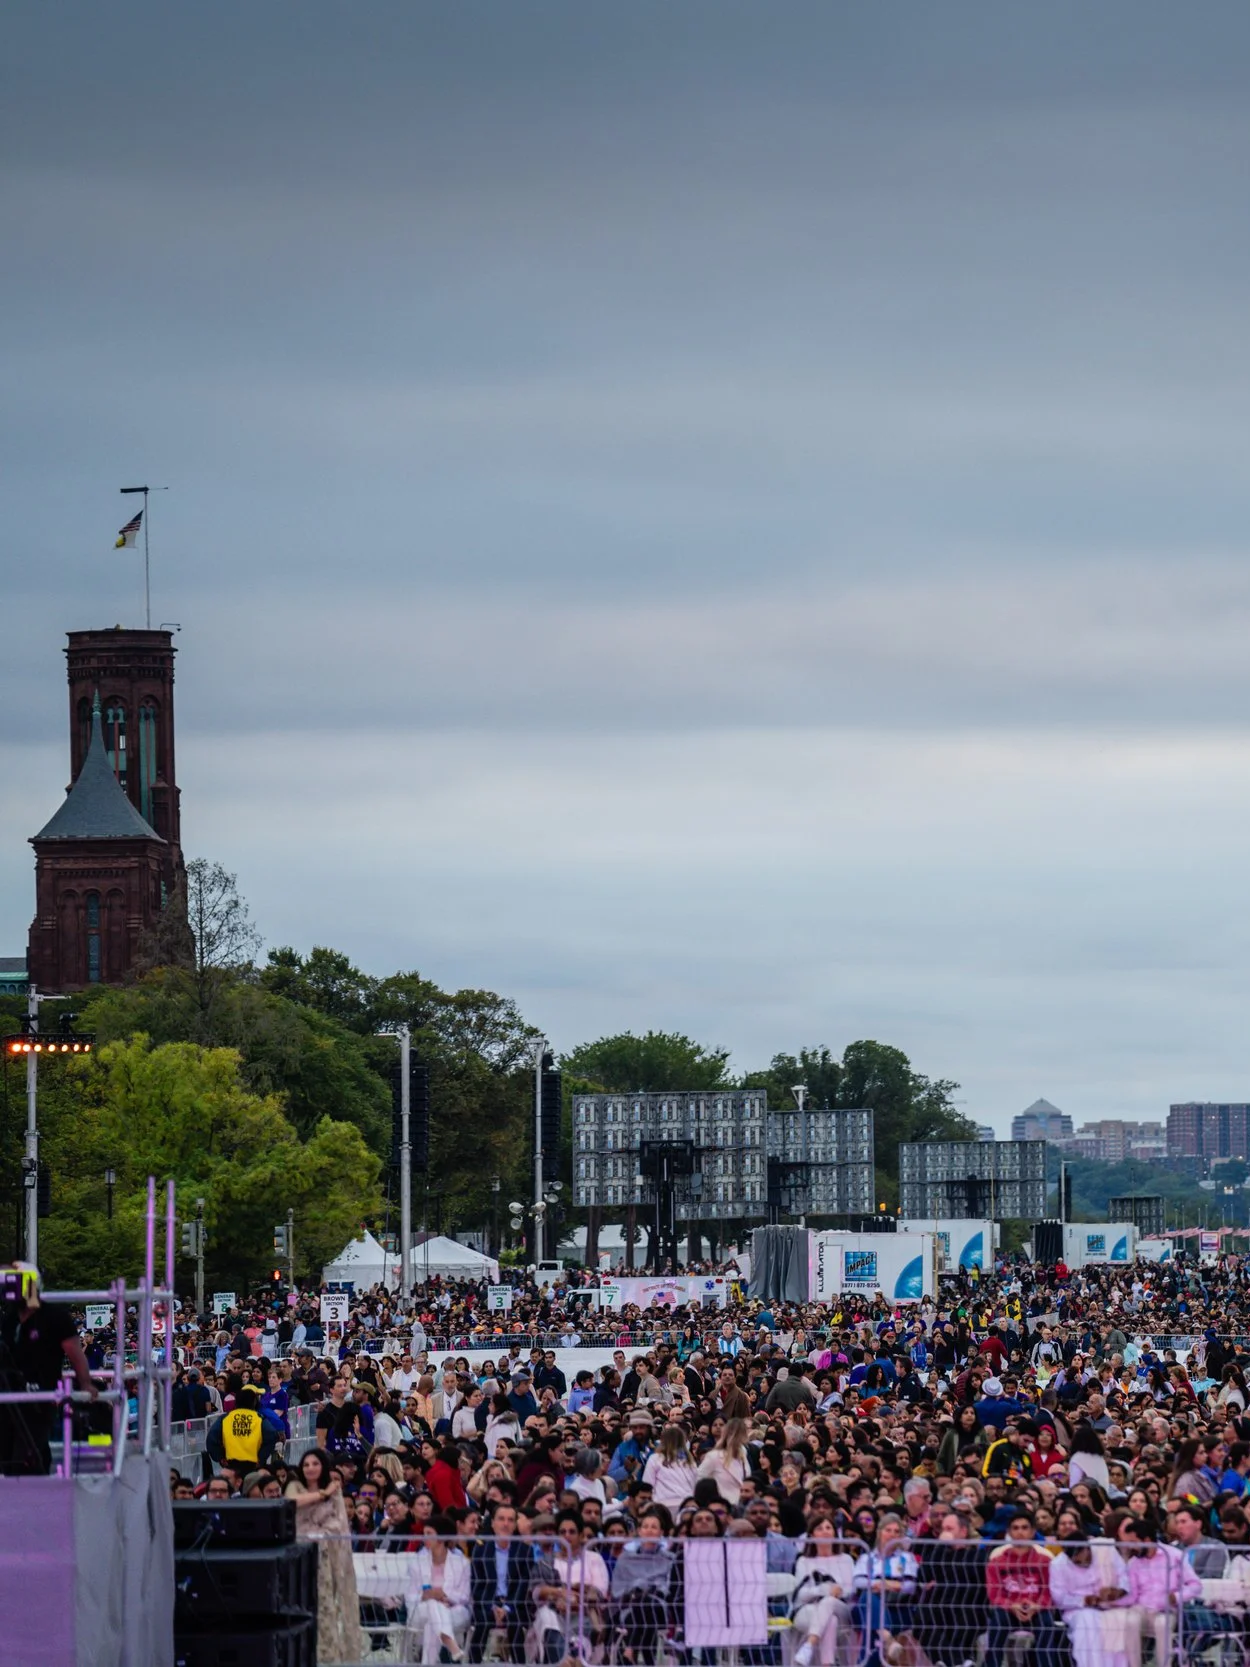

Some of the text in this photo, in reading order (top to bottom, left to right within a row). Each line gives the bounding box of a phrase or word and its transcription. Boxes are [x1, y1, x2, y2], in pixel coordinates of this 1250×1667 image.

[846, 1253, 875, 1274] IMPACT
[496, 1297, 504, 1308] 3
[607, 1295, 614, 1304] 7
[221, 1303, 228, 1312] 8
[330, 1307, 339, 1320] 3
[95, 1316, 103, 1326] 4
[233, 1413, 253, 1422] CSC
[232, 1421, 252, 1429] EVENT
